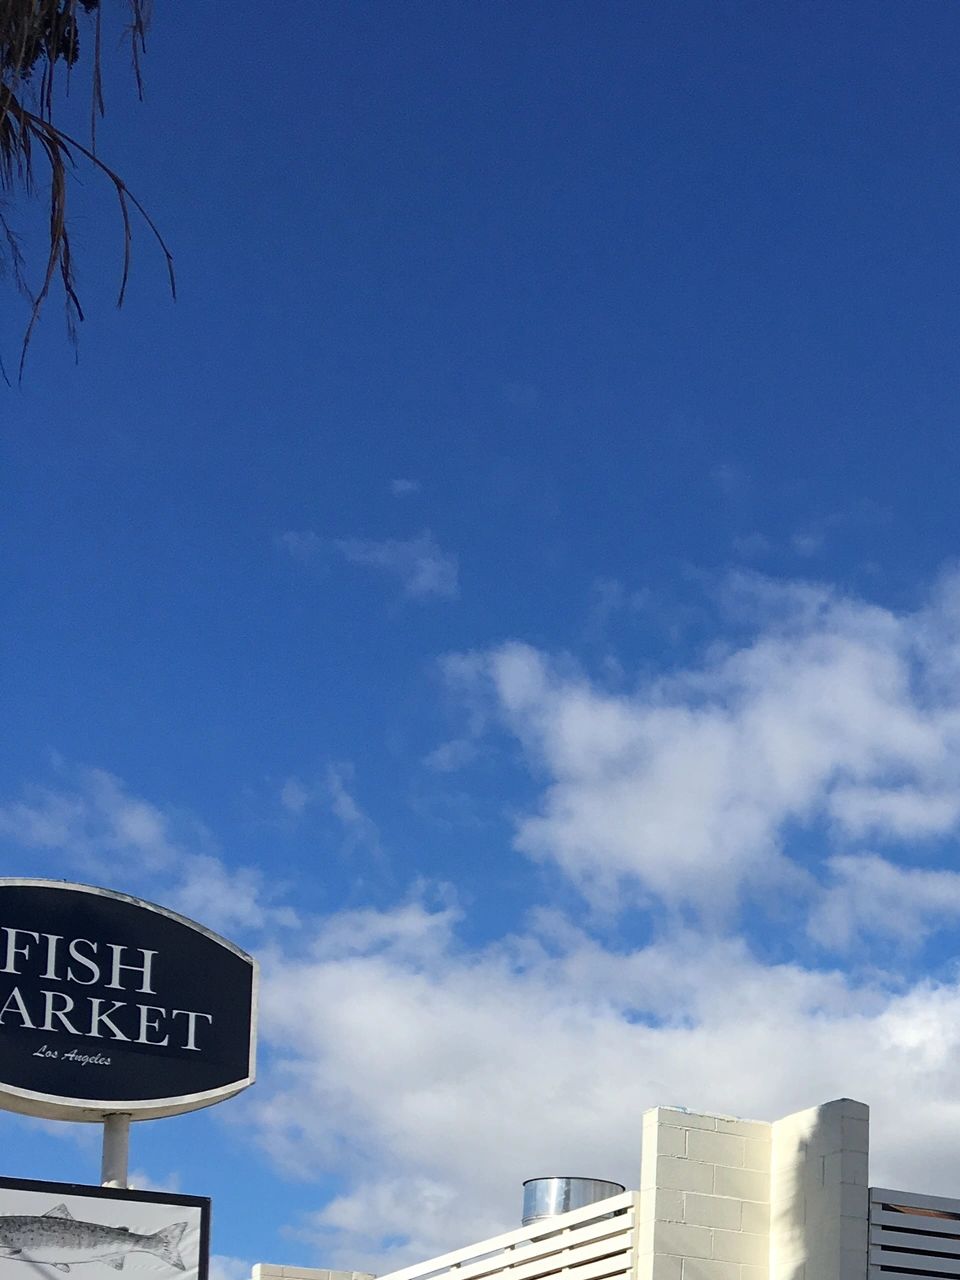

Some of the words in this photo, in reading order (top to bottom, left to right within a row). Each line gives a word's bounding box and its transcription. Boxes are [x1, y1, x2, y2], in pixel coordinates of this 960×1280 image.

[1, 927, 159, 995] FISH
[33, 1045, 58, 1059] Los
[61, 1049, 111, 1066] Angeles
